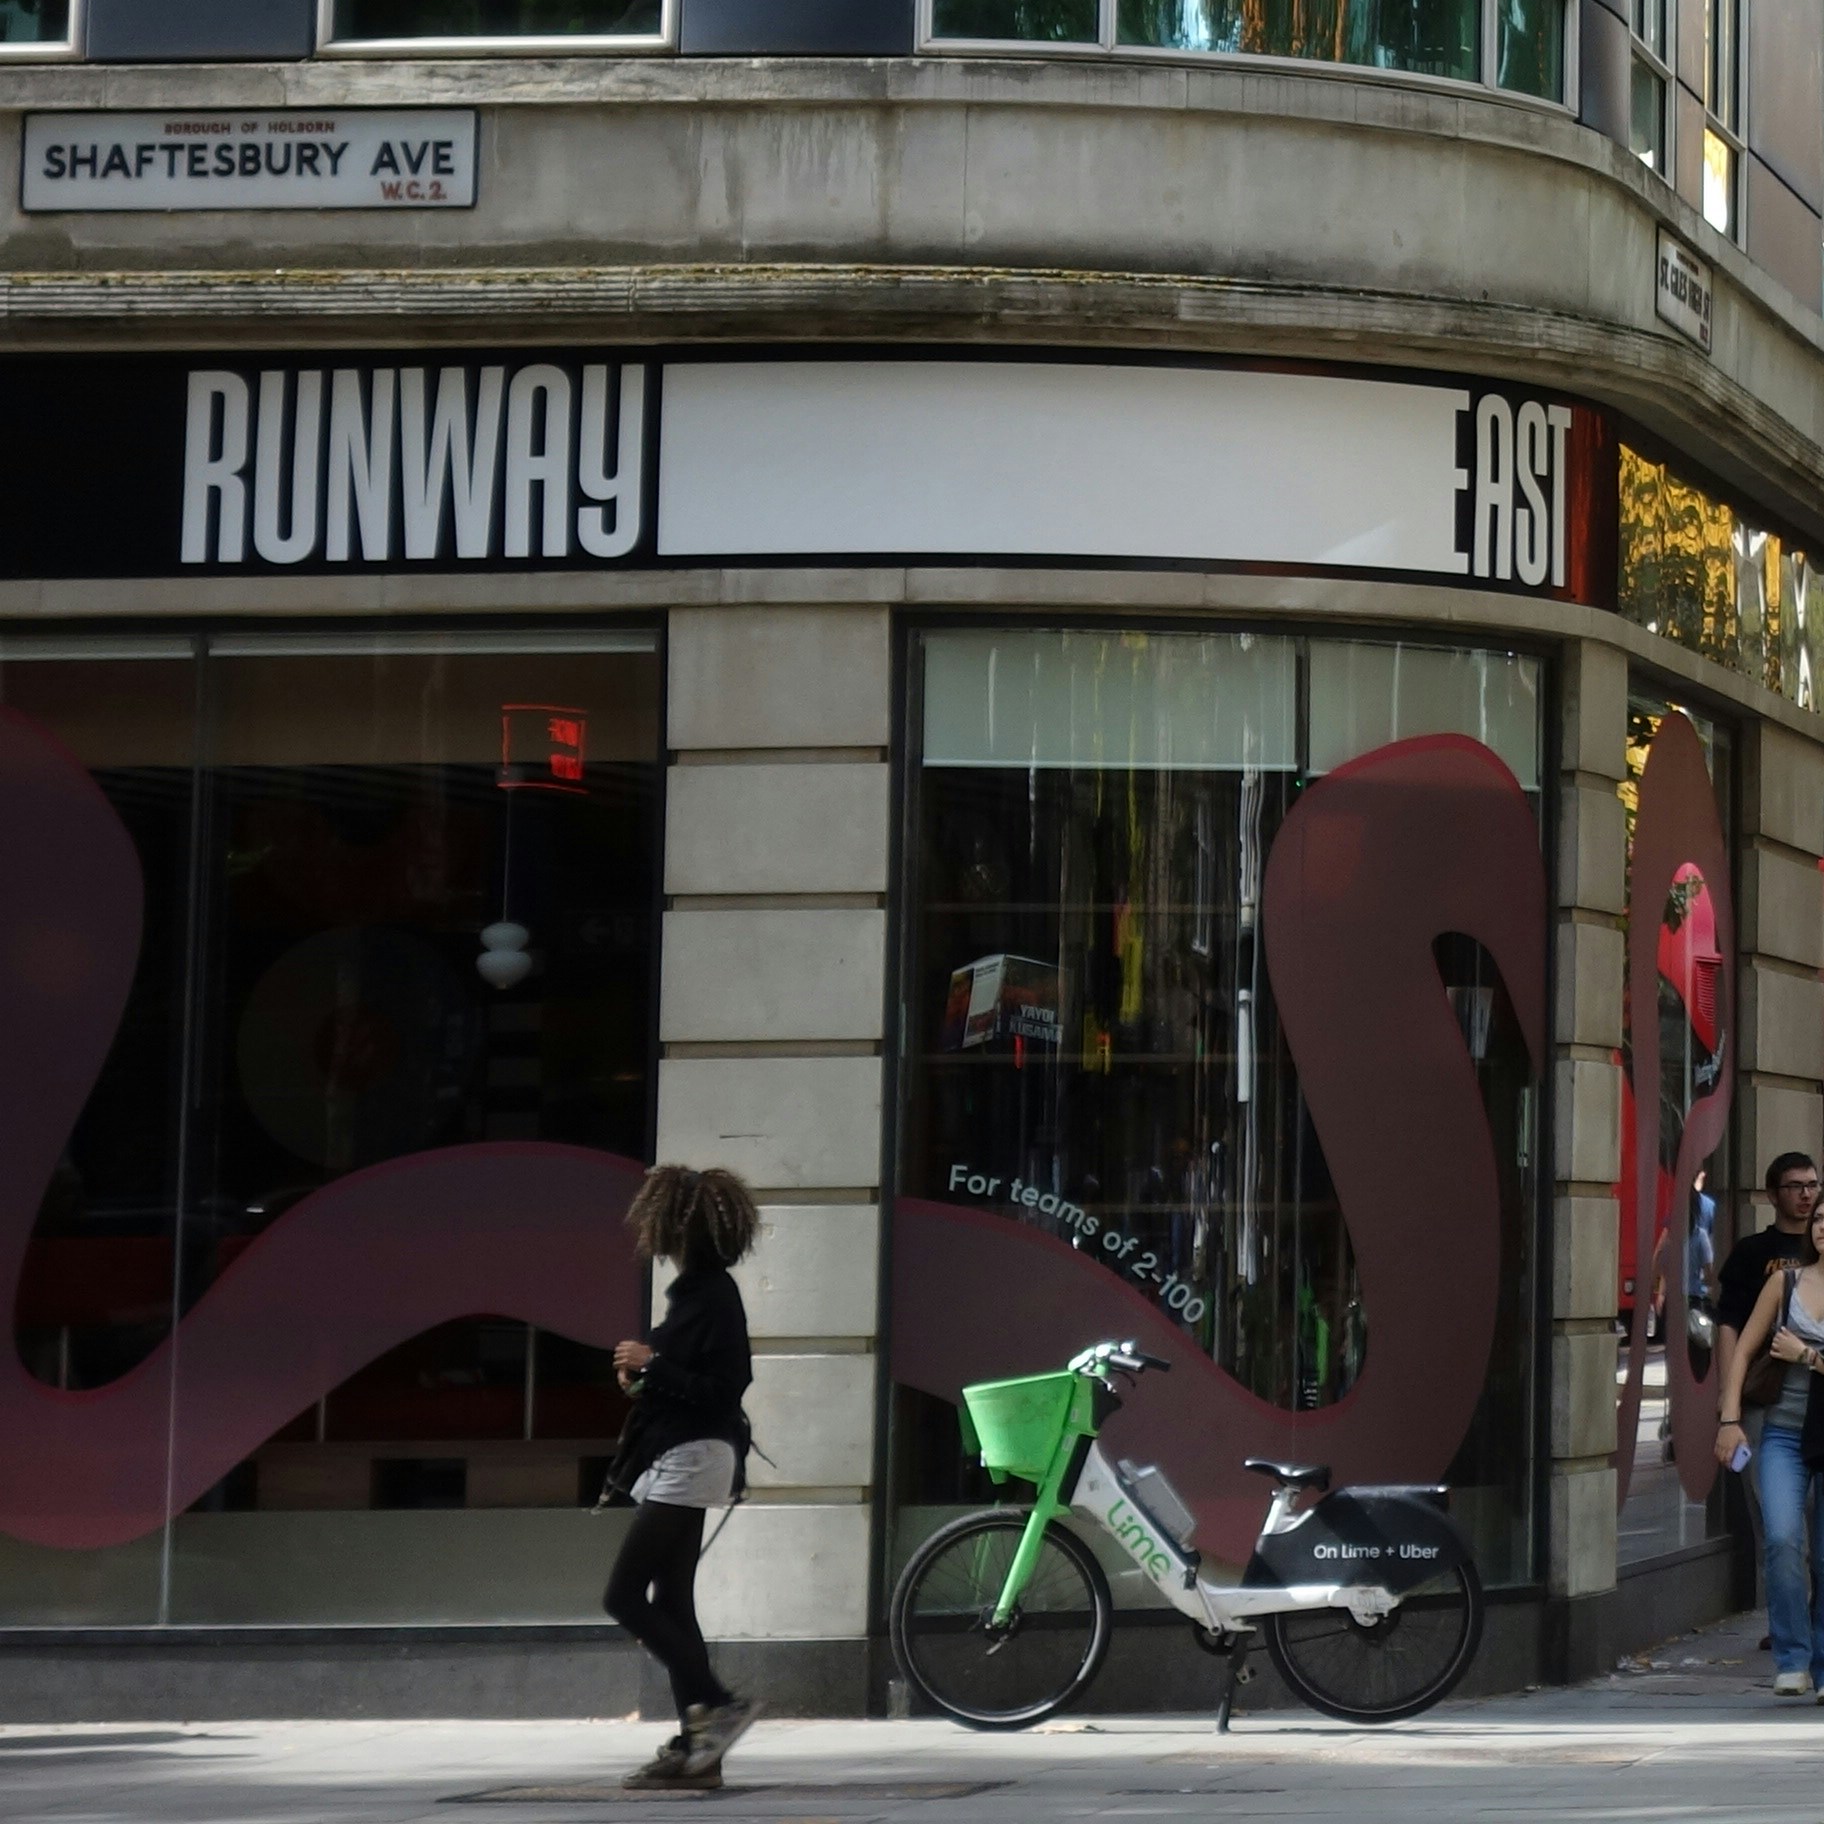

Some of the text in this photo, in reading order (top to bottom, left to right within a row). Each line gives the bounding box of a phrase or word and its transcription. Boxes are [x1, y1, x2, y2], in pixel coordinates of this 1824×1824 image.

[165, 121, 335, 135] BOROUGH OF HOLBORN
[43, 140, 454, 179] SHAFTESBURY AVE
[181, 363, 1572, 588] RUNWAY EAST
[949, 1165, 1204, 1323] For teams of 2-100
[1106, 1498, 1172, 1580] Lime
[1314, 1544, 1339, 1560] On
[1341, 1543, 1380, 1560] Lime
[1399, 1543, 1439, 1560] Uber
